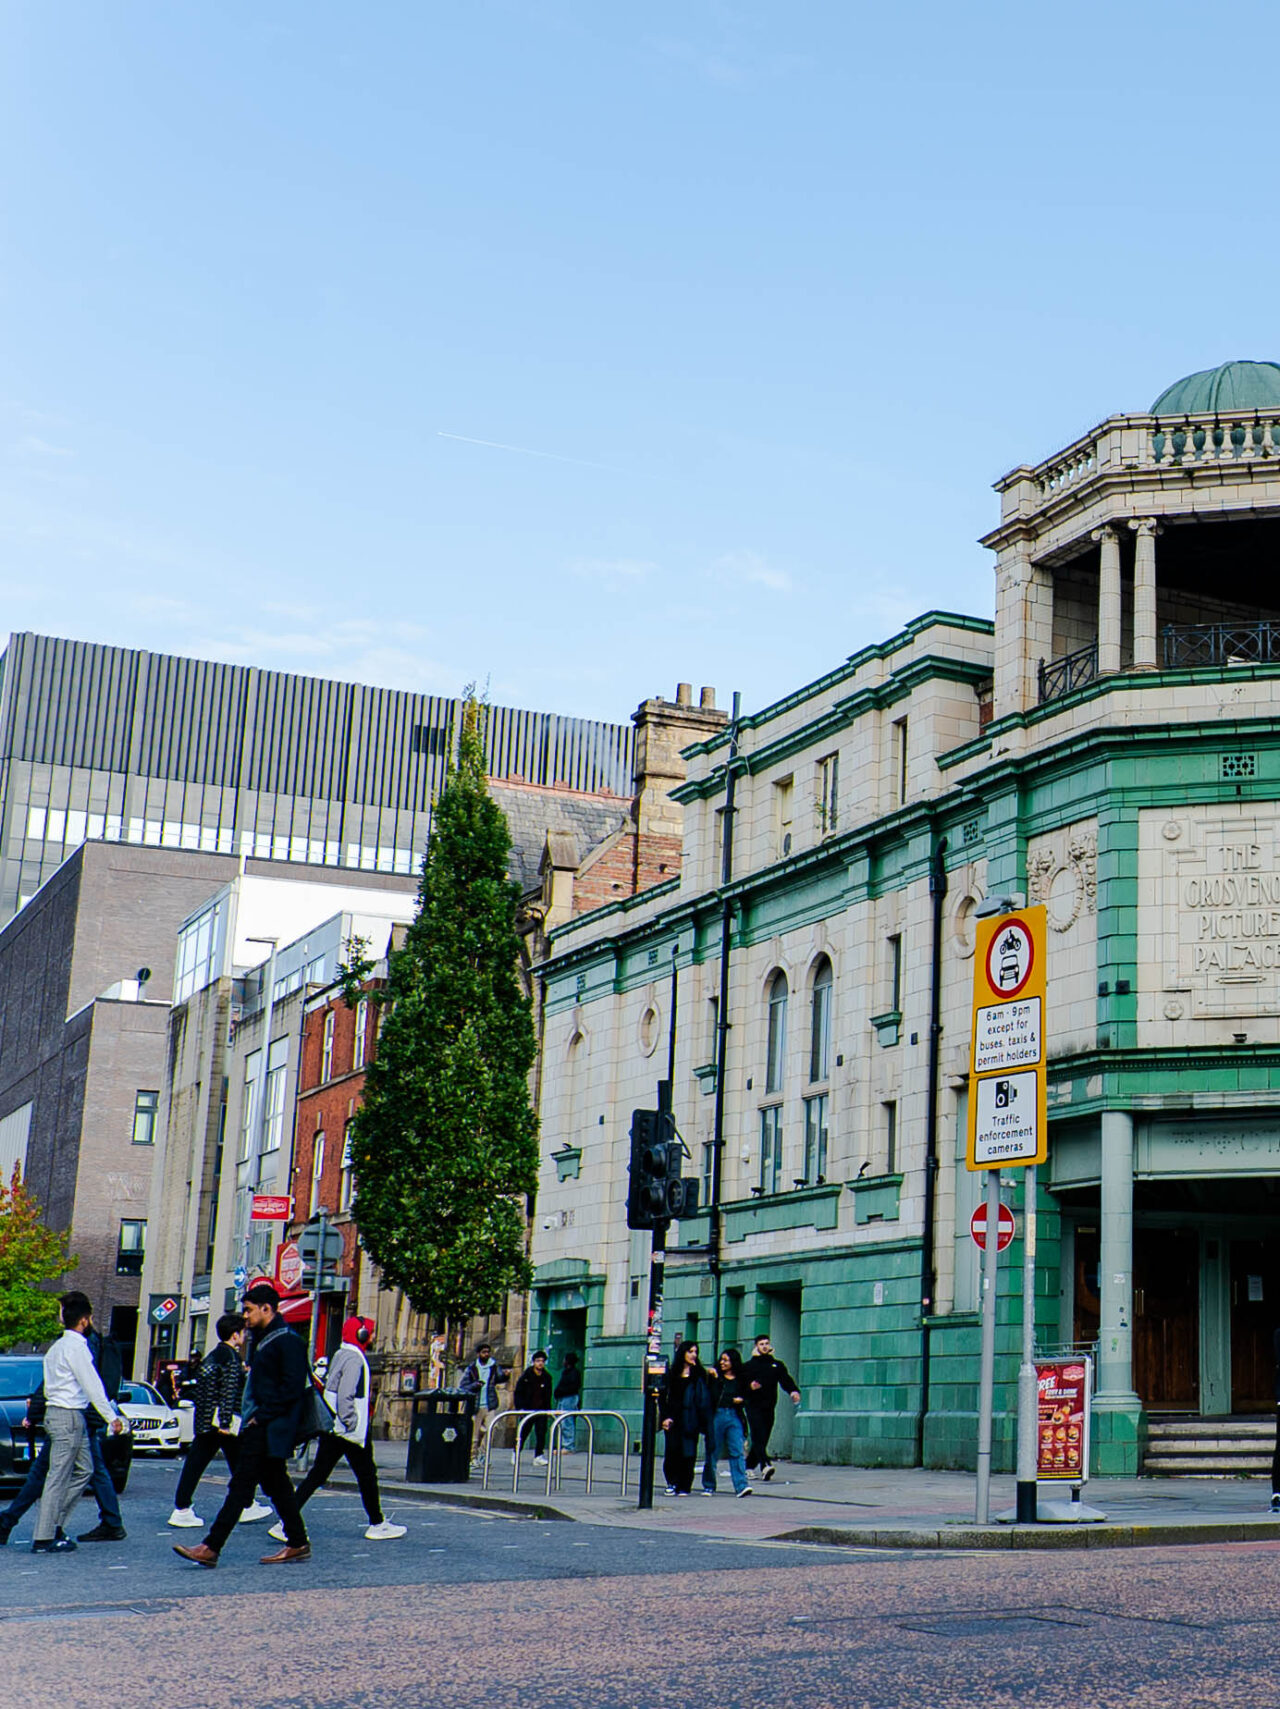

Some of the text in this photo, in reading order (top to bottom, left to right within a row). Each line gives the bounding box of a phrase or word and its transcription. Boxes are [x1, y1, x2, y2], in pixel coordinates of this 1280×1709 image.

[1218, 845, 1261, 871] THE
[986, 1011, 1004, 1021] 6am
[1012, 1006, 1031, 1017] 9pm
[987, 1019, 1028, 1035] except for
[1008, 1033, 1028, 1046] taxis
[1029, 1032, 1036, 1042] &
[978, 1048, 1037, 1068] permit holders
[992, 1113, 1020, 1127] Traffic
[978, 1125, 1033, 1142] enforcement
[988, 1143, 1023, 1154] cameras
[1037, 1375, 1056, 1391] REE
